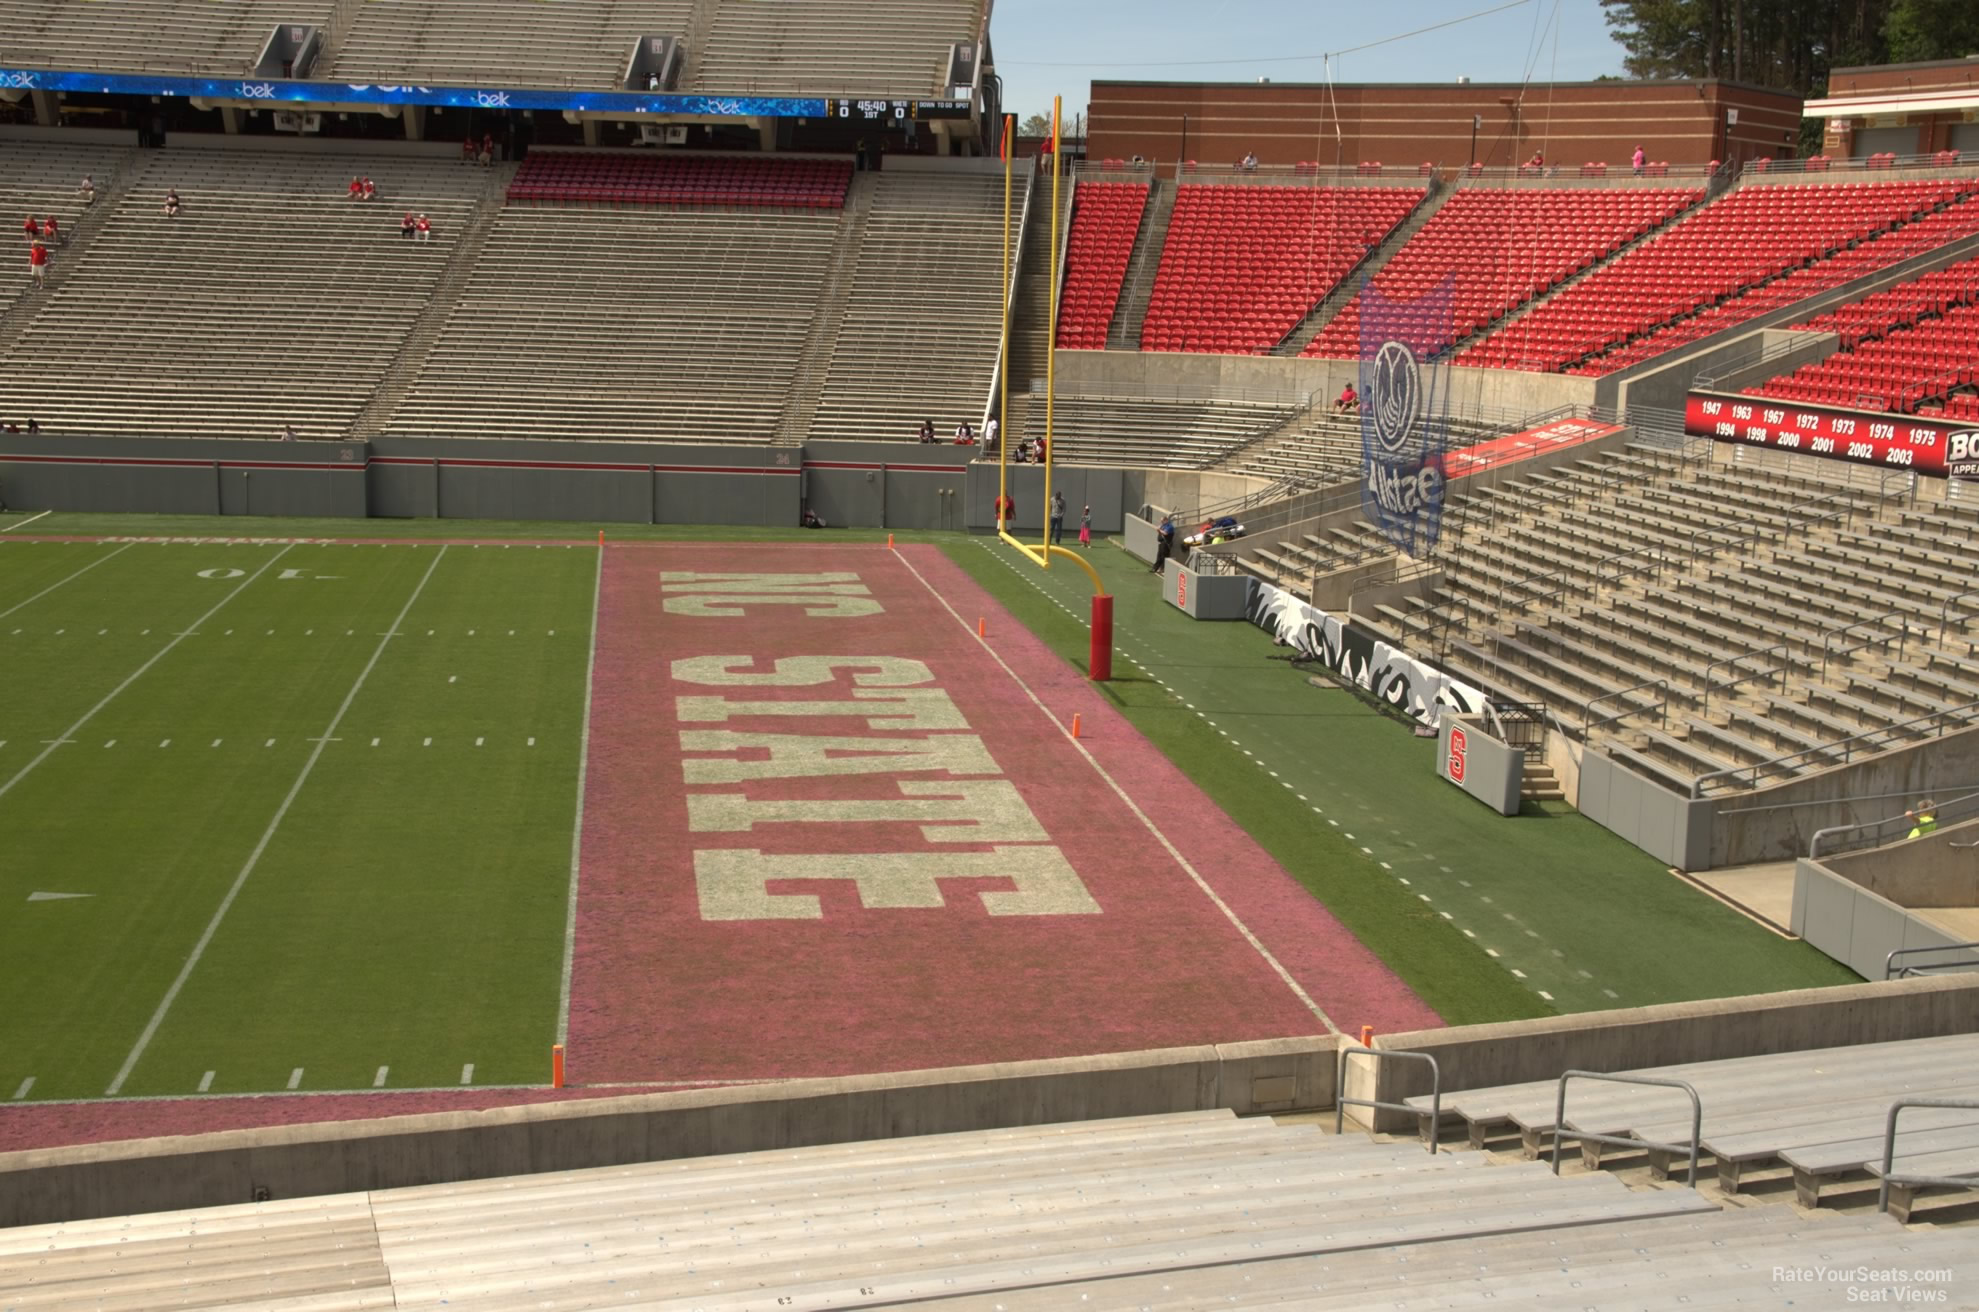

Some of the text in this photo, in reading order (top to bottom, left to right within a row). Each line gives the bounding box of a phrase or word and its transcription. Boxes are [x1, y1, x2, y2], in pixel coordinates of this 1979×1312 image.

[242, 82, 275, 98] belk
[477, 90, 511, 107] belk
[840, 107, 849, 117] 0
[857, 101, 886, 111] 45:40
[895, 108, 904, 118] 0
[1702, 401, 1936, 446] 1947 1963 1967 1972 1973 1974 1975
[1716, 422, 1913, 465] 1994 1998 2000 2001 2002 2003
[659, 570, 886, 617] NC
[670, 654, 1104, 922] STATE
